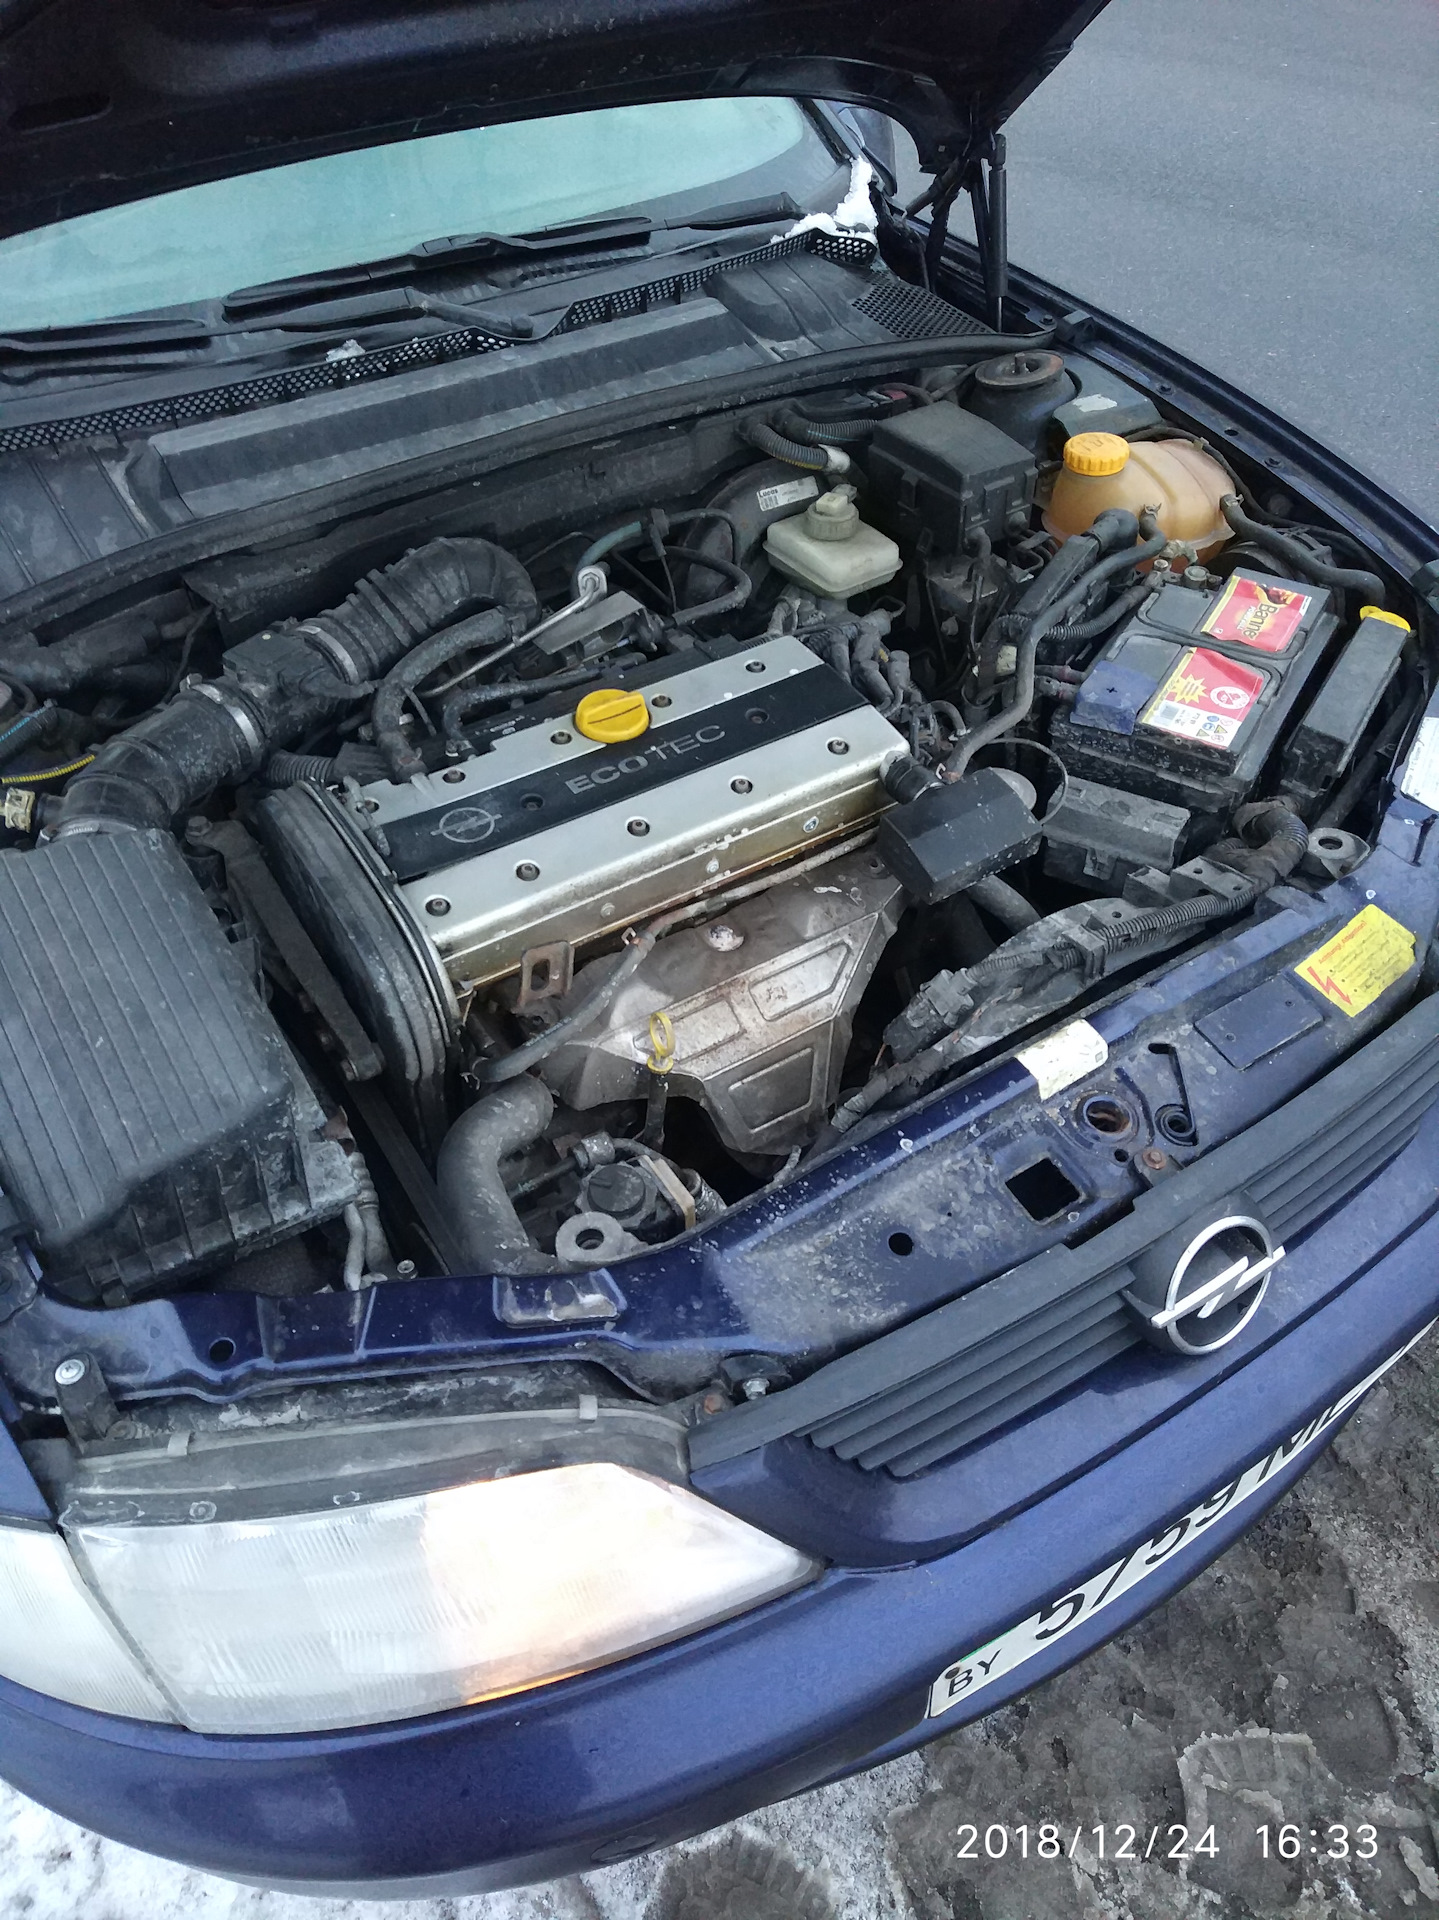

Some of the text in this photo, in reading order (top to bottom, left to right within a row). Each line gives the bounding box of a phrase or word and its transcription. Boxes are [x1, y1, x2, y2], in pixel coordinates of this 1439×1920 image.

[758, 488, 779, 498] Lucas
[565, 725, 725, 794] ECOTEC
[947, 1649, 1001, 1698] BY
